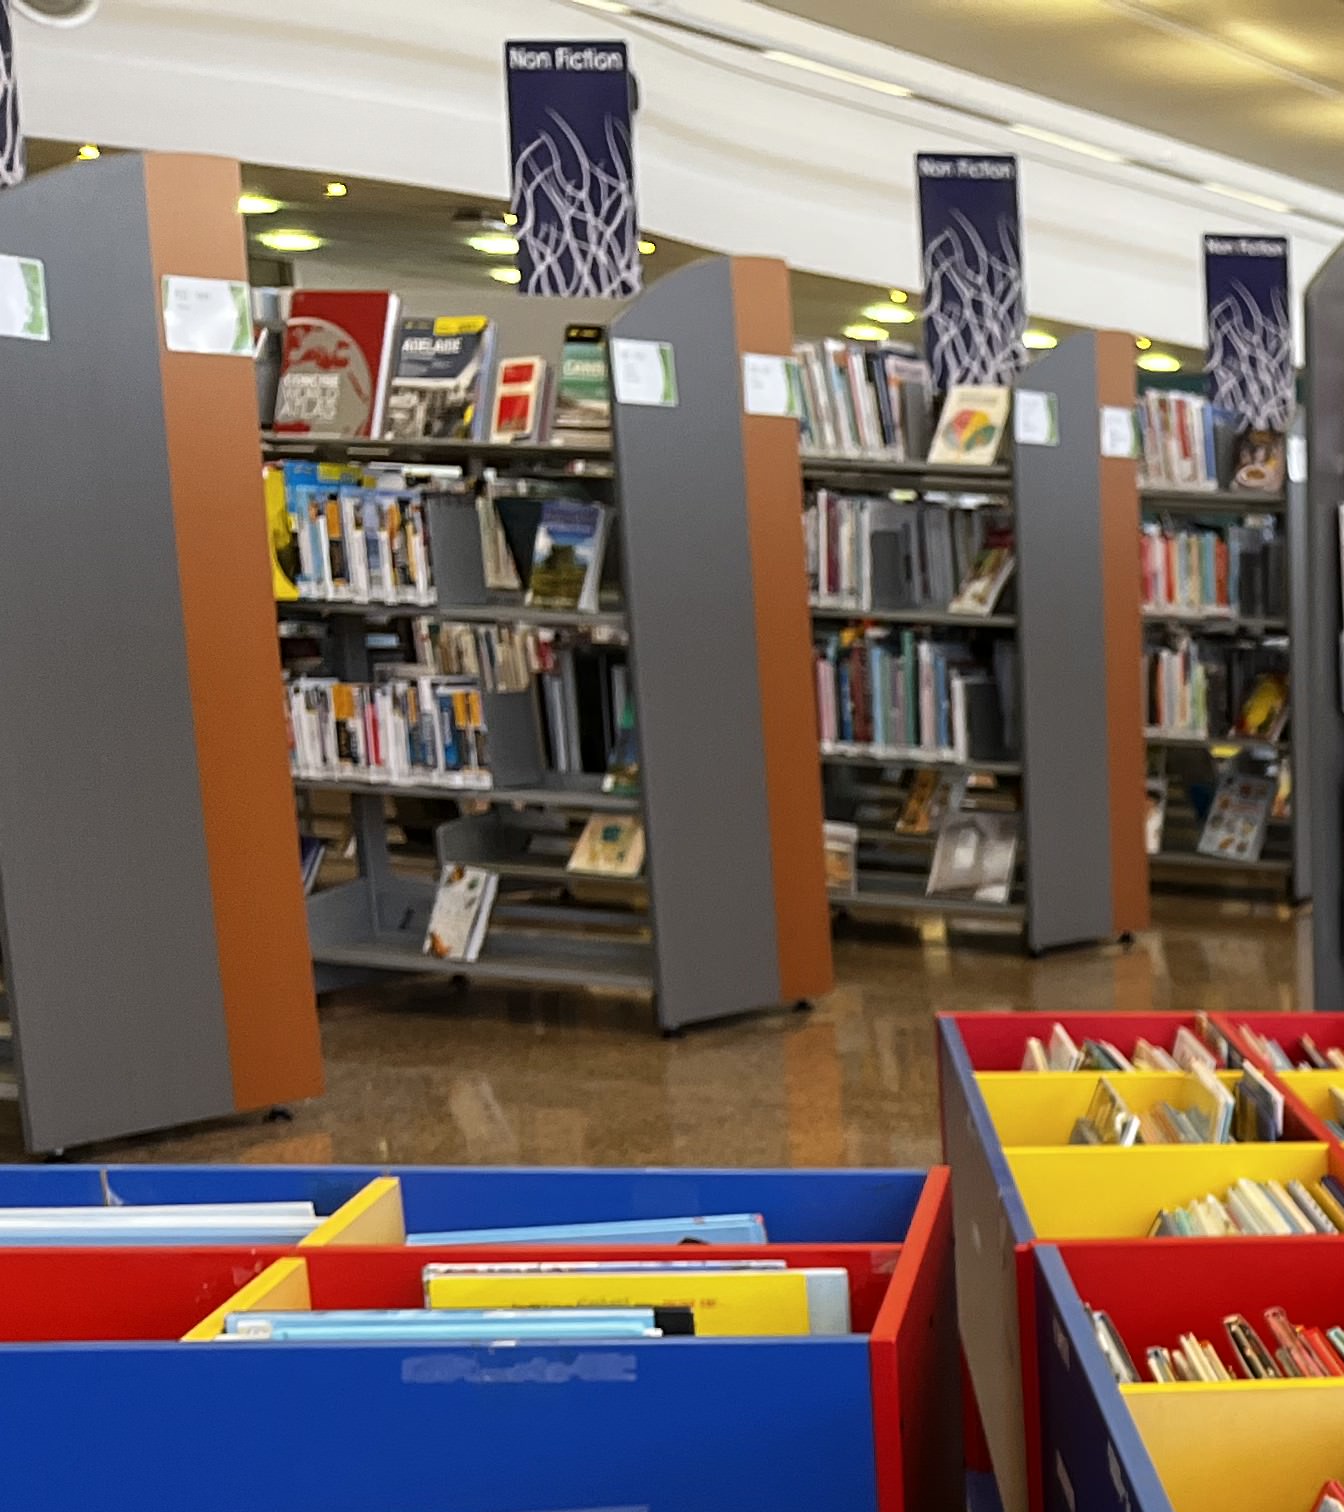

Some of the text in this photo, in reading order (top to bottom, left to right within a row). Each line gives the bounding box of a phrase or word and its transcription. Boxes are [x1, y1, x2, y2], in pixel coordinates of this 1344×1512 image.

[510, 47, 623, 71] Non Fiction
[919, 159, 1015, 179] Non Fiction
[402, 337, 463, 354] ADELAIDE
[278, 399, 338, 418] ATLAS
